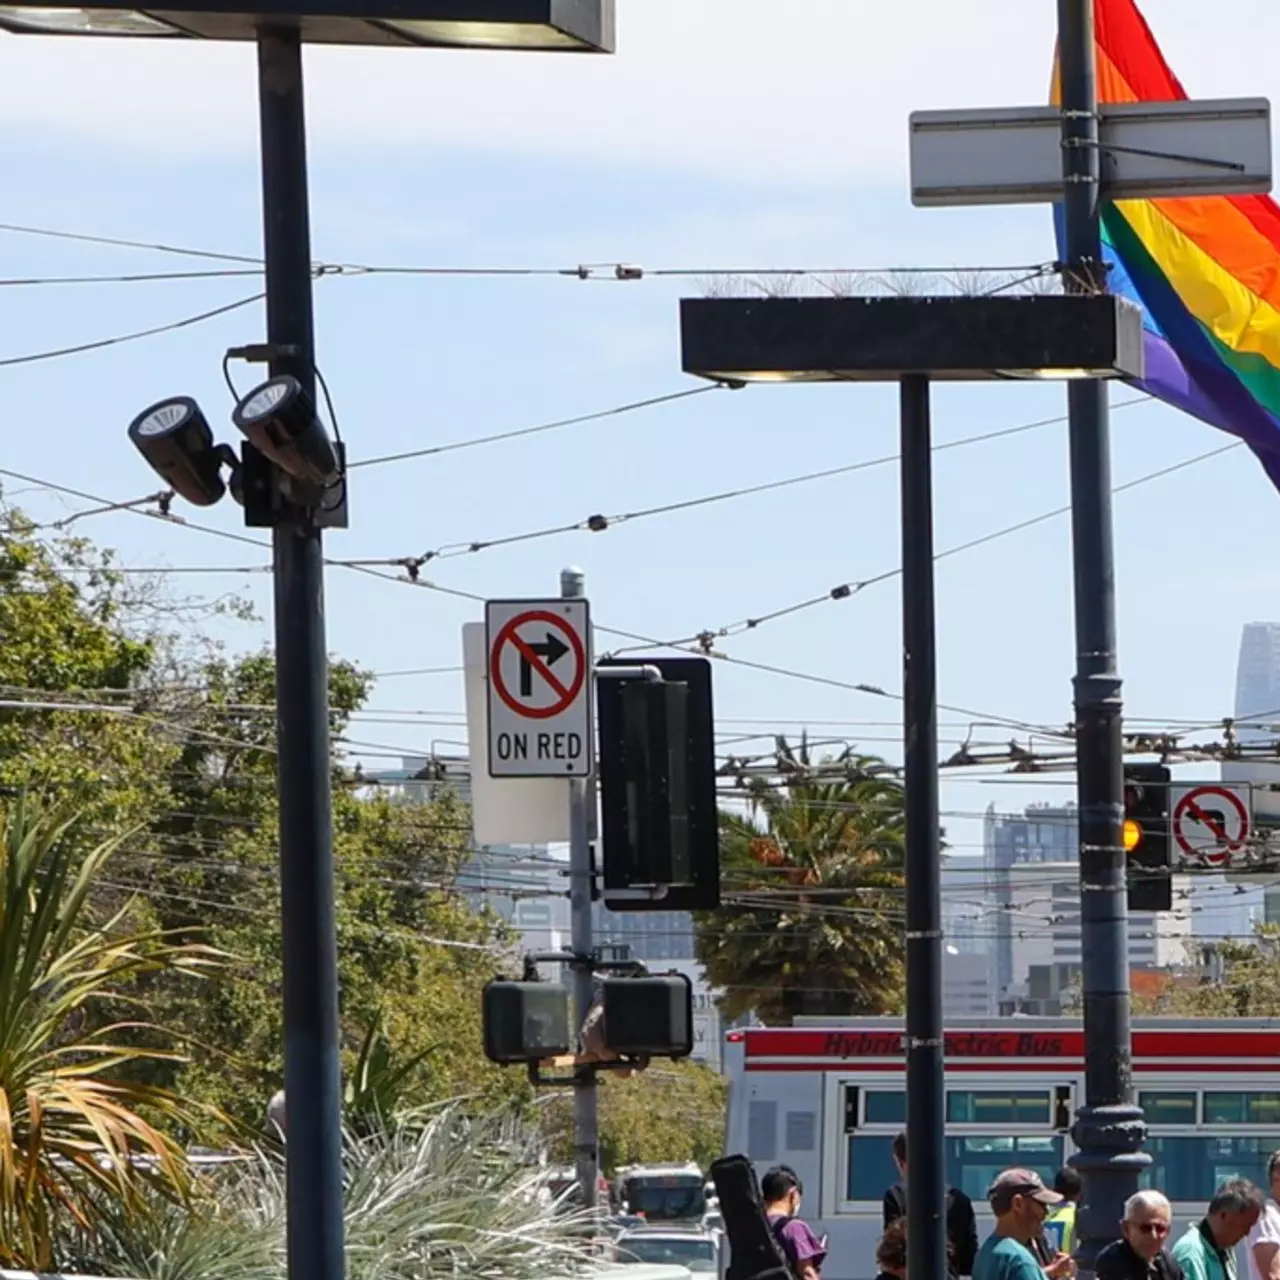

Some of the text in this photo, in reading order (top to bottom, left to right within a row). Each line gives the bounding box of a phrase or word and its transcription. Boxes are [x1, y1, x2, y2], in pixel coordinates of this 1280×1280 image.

[498, 733, 581, 760] ON RED
[1016, 1033, 1063, 1056] Bus
